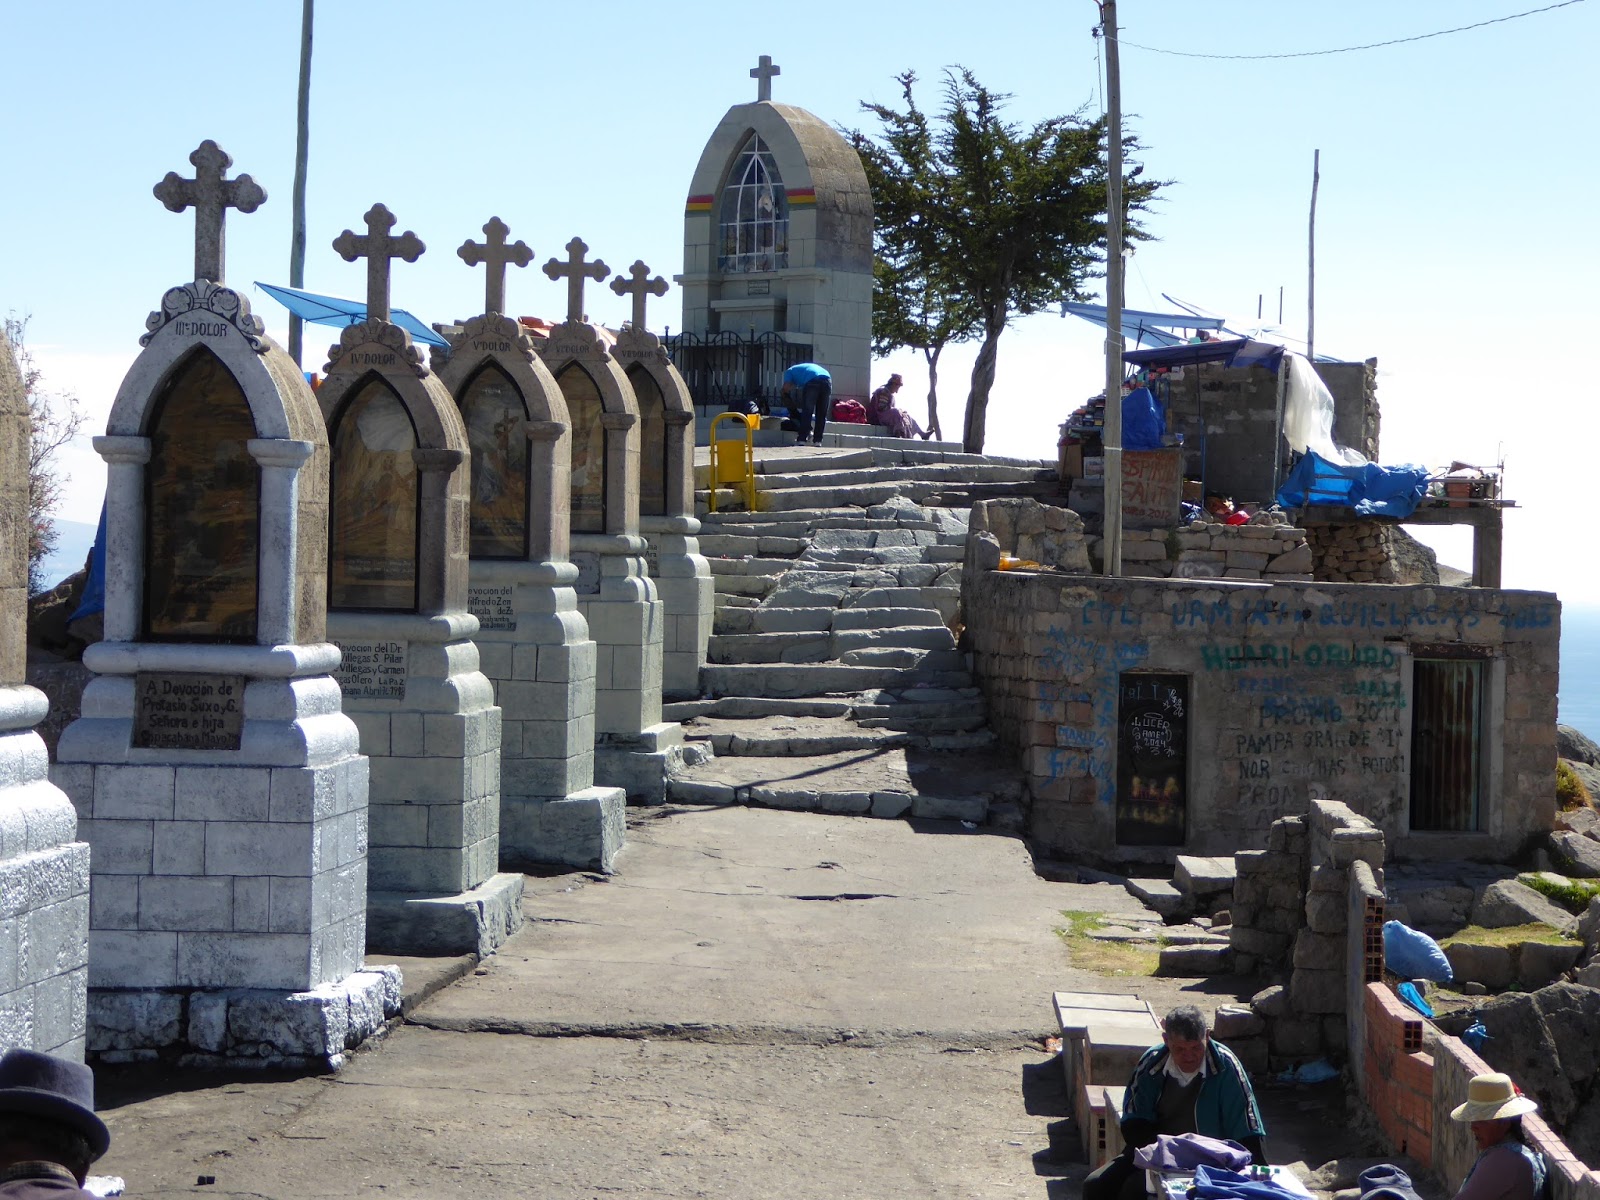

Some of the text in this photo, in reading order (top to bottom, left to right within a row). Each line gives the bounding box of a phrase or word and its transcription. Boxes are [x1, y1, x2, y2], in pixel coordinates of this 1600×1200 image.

[191, 322, 228, 337] DOLOR
[483, 341, 511, 352] DOLOR
[364, 353, 396, 365] DOLOR
[500, 586, 513, 596] del
[1318, 601, 1481, 628] QUILLACAS
[374, 642, 388, 653] del
[384, 653, 404, 664] Pilar
[339, 663, 371, 675] Villegas
[377, 664, 405, 675] Carmen
[146, 680, 158, 695] A
[218, 680, 233, 696] de
[148, 713, 188, 728] Señora
[192, 719, 199, 729] e
[1236, 731, 1294, 755] PAMPA
[1238, 758, 1271, 780] NOR
